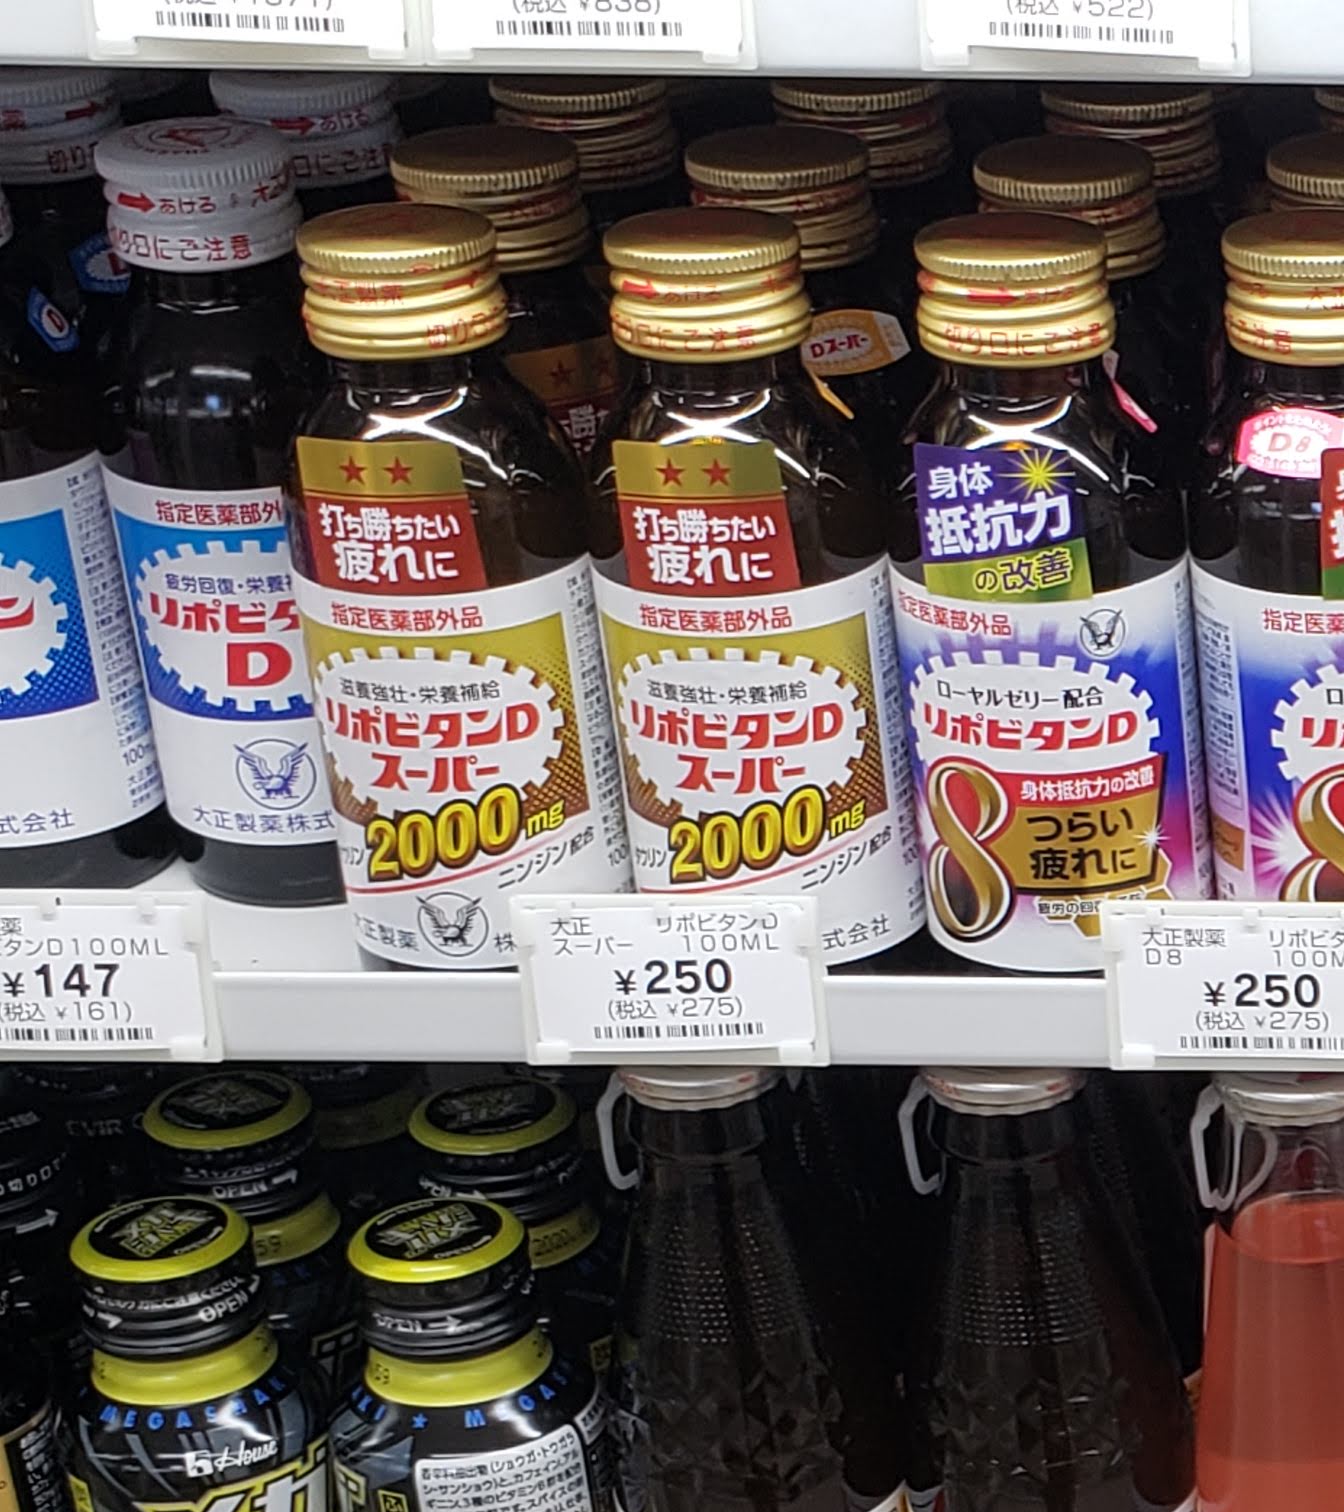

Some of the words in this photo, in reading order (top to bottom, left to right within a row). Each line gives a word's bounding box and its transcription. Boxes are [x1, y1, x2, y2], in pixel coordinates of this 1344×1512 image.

[928, 462, 992, 500] 身体
[320, 503, 460, 541] 打ち勝ちたい
[633, 506, 776, 545] 打ち勝ちたい
[924, 493, 1070, 556] 抵抗力
[334, 539, 458, 583] 疲れに
[647, 541, 771, 585] 疲れに
[975, 550, 1071, 594] の改善
[331, 603, 483, 634] 指定医薬部外品
[327, 700, 539, 749] リポビタンD
[630, 702, 844, 751] リポビタンD
[923, 703, 1138, 751] リポビタンD
[371, 752, 500, 794] スーパー
[679, 754, 805, 794] スーパー
[1021, 766, 1154, 801] 身体抵抗力の改善
[368, 784, 520, 881] 2000
[526, 798, 564, 837] mg
[669, 786, 824, 883] 2000
[1026, 808, 1132, 843] つらい
[1031, 843, 1135, 880] 疲れに
[552, 916, 590, 937] 大正
[655, 913, 778, 933] リポビタンD
[555, 937, 633, 954] スーパー
[683, 934, 780, 953] 100ML
[1142, 929, 1225, 948] 大正製薬
[1145, 949, 1182, 965] D8
[3, 962, 120, 1000] ¥147
[615, 958, 733, 998] ¥250
[1204, 974, 1320, 1008] ¥250
[608, 998, 659, 1023] (税込
[664, 996, 744, 1021] ¥275)
[1255, 1011, 1328, 1032] ¥275)
[215, 1439, 277, 1472] House
